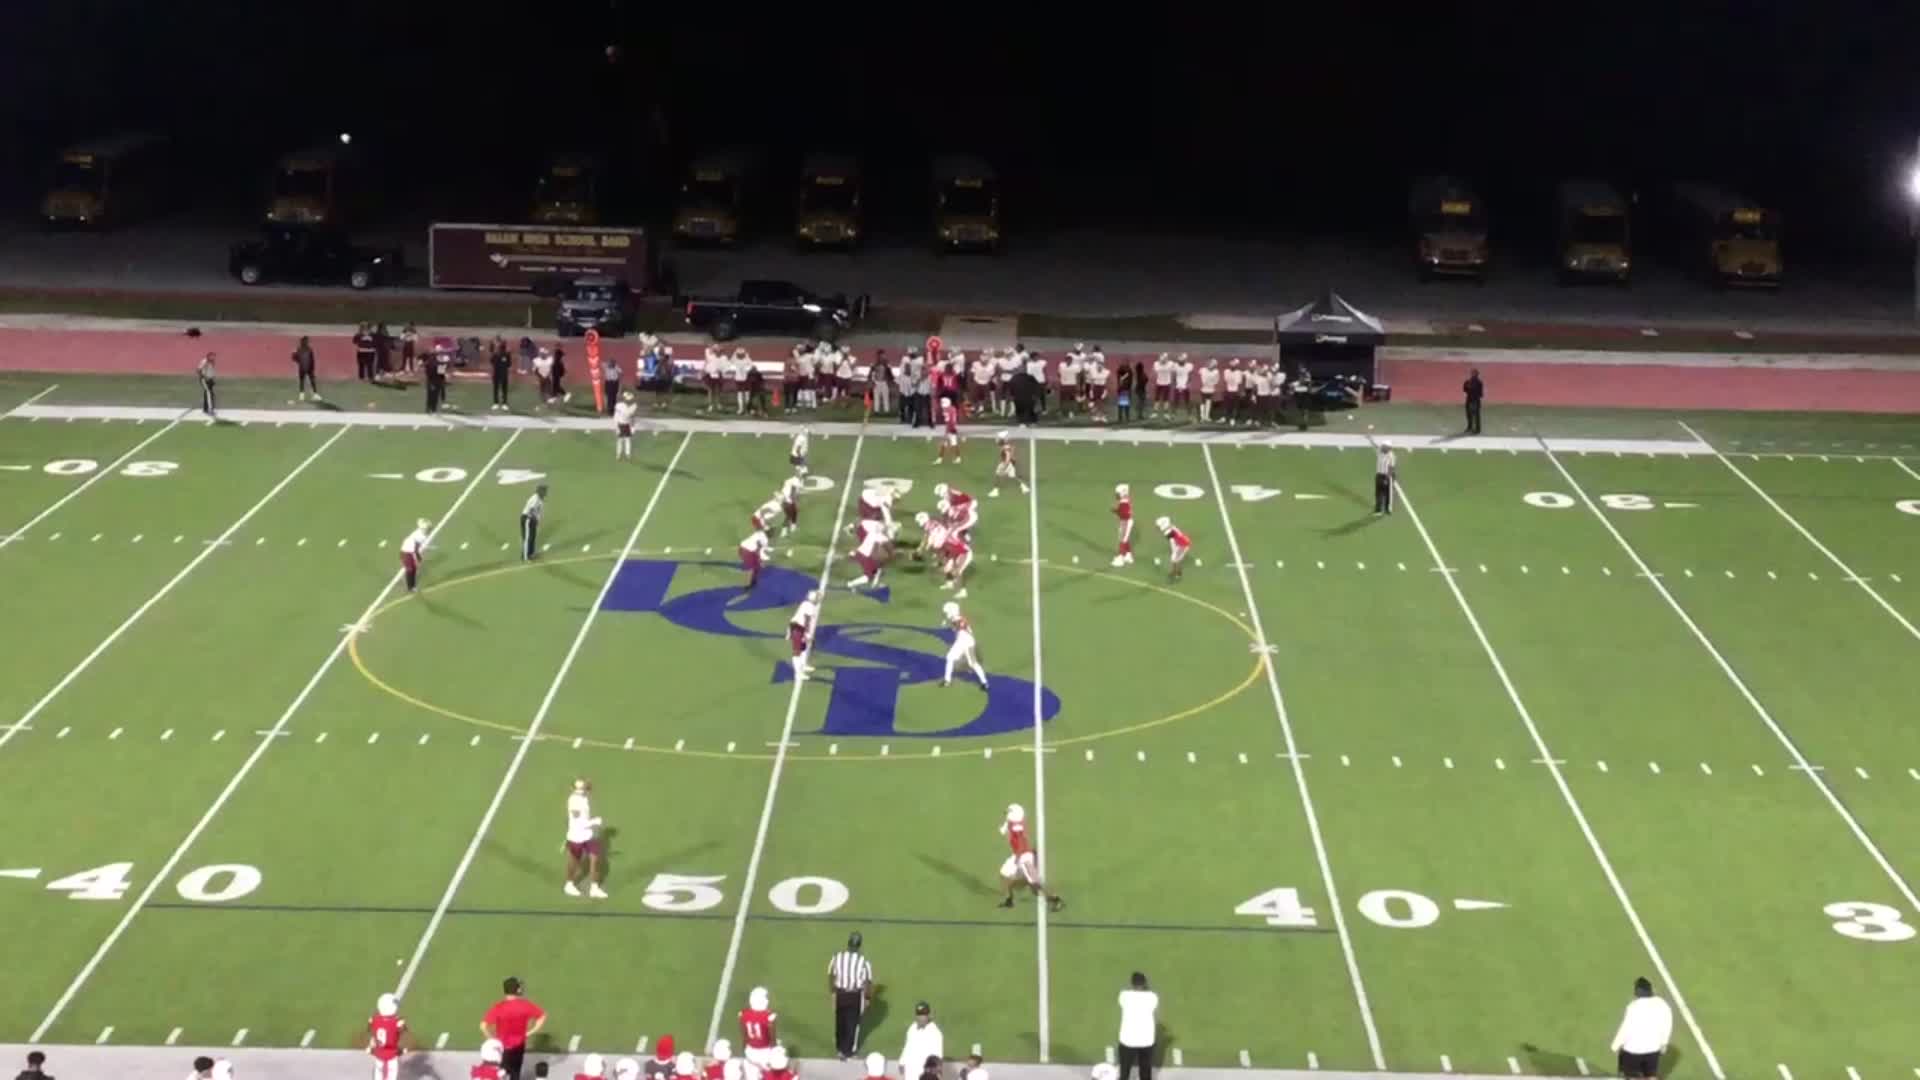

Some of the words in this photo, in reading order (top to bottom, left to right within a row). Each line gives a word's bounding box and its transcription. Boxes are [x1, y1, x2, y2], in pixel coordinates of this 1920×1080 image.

[554, 234, 596, 246] SCHOOL
[46, 861, 262, 901] 40
[640, 873, 849, 914] 50
[1234, 887, 1440, 928] 40
[1823, 901, 1916, 941] 3
[376, 1027, 387, 1047] 9
[746, 1021, 761, 1039] 11
